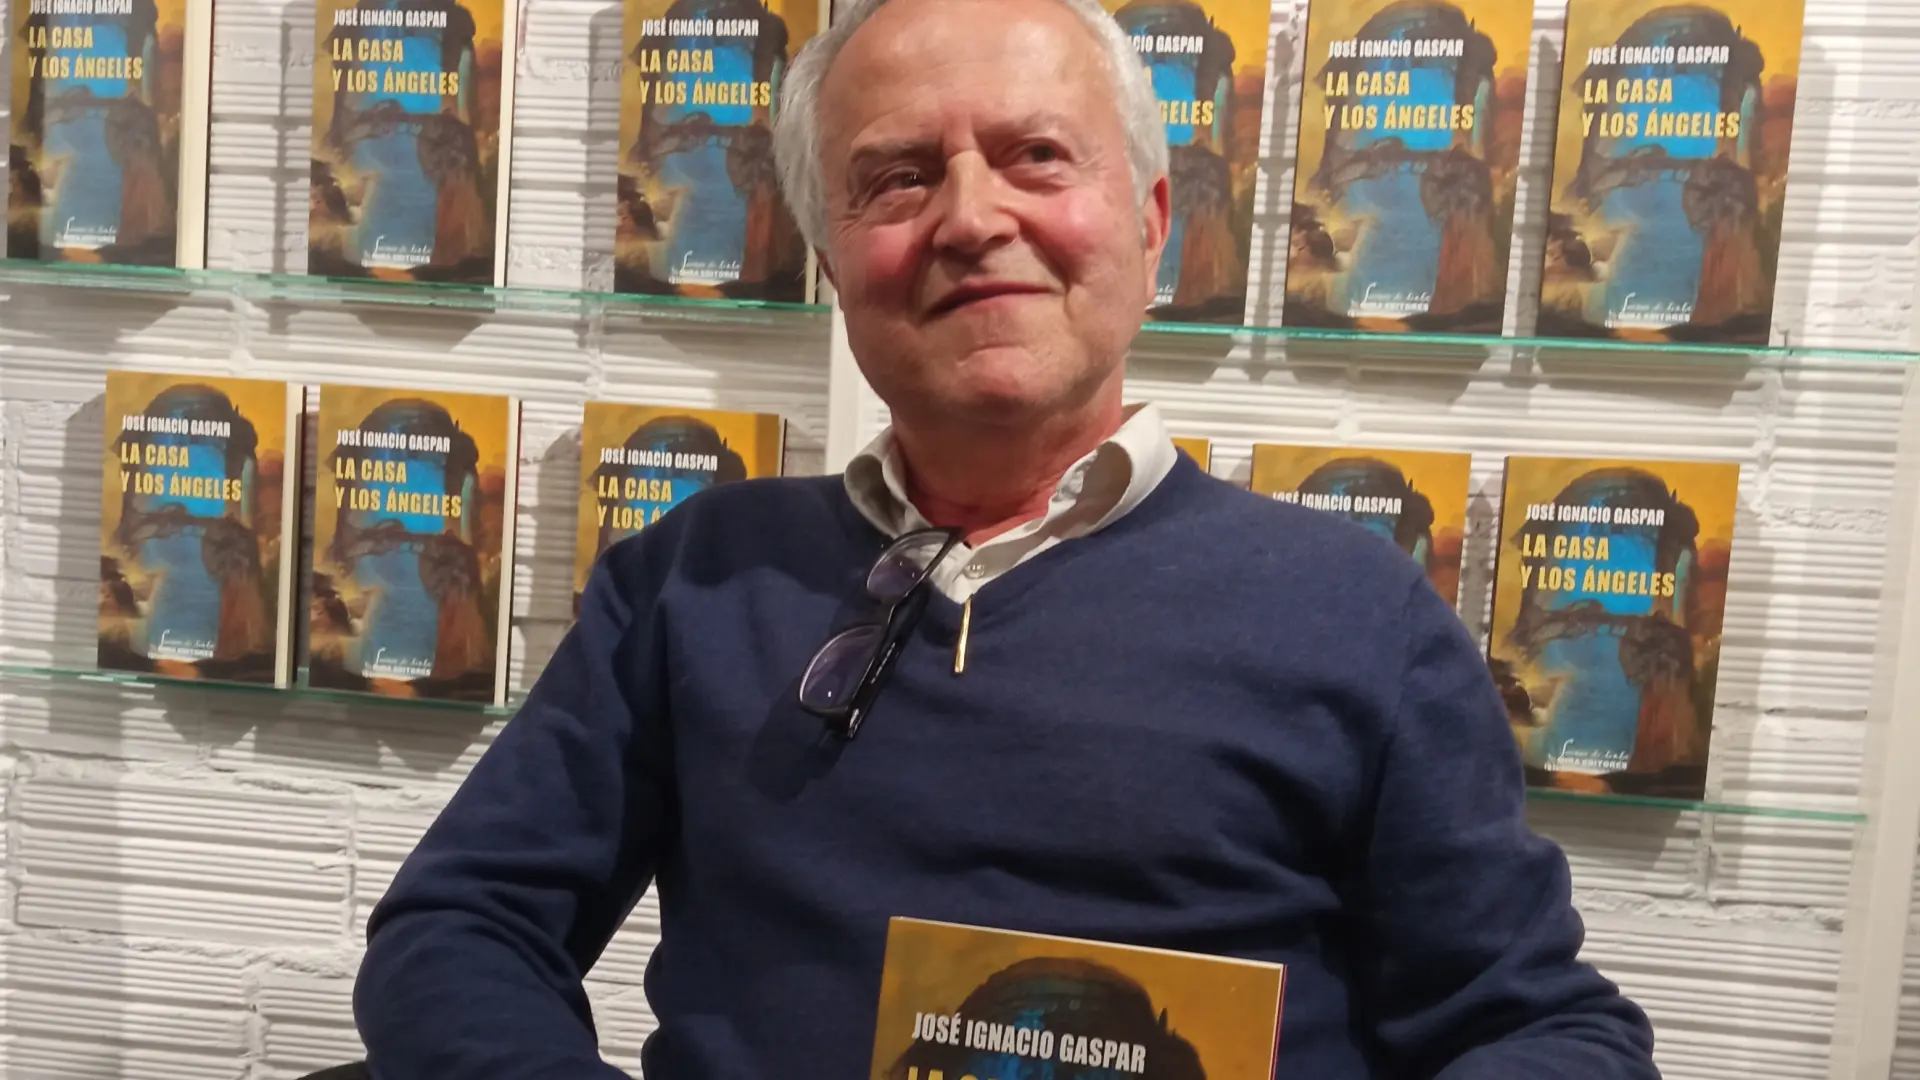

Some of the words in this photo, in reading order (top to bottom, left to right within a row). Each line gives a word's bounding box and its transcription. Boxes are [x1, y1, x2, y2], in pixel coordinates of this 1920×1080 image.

[334, 9, 357, 26] JOSÉ
[360, 10, 403, 27] IGNACIO
[405, 10, 447, 28] GASPAR
[641, 16, 666, 37] JOSÉ
[668, 18, 714, 36] IGNACIO
[716, 19, 759, 36] GASPAR
[28, 26, 47, 48] LA
[52, 26, 93, 48] CASA
[333, 38, 353, 62] LA
[358, 39, 404, 62] CASA
[1156, 35, 1203, 53] GASPAR
[1329, 37, 1357, 58] JOSÉ
[1360, 39, 1411, 57] IGNACIO
[1413, 39, 1464, 57] GASPAR
[28, 56, 37, 77] Y
[42, 56, 69, 78] LOS
[74, 53, 143, 79] ÁNGELES
[640, 49, 661, 73] LA
[666, 49, 714, 73] CASA
[1587, 44, 1617, 65] JOSÉ
[1620, 46, 1674, 65] IGNACIO
[1677, 46, 1729, 64] GASPAR
[332, 69, 342, 92] Y
[347, 69, 378, 93] LOS
[383, 68, 459, 96] ÁNGELES
[640, 80, 650, 104] Y
[655, 80, 687, 105] LOS
[692, 76, 771, 106] ÁNGELES
[1326, 71, 1349, 97] LA
[1355, 71, 1410, 97] CASA
[1584, 78, 1609, 104] LA
[1615, 78, 1673, 104] CASA
[1324, 104, 1335, 129] Y
[1341, 104, 1378, 130] LOS
[1383, 100, 1475, 130] ÁNGELES
[1582, 112, 1594, 138] Y
[1599, 112, 1638, 138] LOS
[1644, 108, 1740, 138] ÁNGELES
[122, 414, 145, 432] JOSÉ
[147, 416, 189, 435] IGNACIO
[190, 419, 231, 438] GASPAR
[337, 428, 361, 446] JOSÉ
[363, 430, 407, 450] IGNACIO
[408, 433, 451, 453] GASPAR
[121, 442, 140, 465] LA
[145, 444, 189, 468] CASA
[600, 447, 625, 465] JOSÉ
[627, 449, 672, 468] IGNACIO
[674, 452, 718, 472] GASPAR
[336, 456, 356, 480] LA
[361, 458, 407, 484] CASA
[120, 470, 130, 493] Y
[134, 472, 165, 495] LOS
[169, 472, 242, 501] ÁNGELES
[599, 475, 619, 499] LA
[624, 477, 672, 503] CASA
[335, 485, 345, 508] Y
[350, 488, 381, 511] LOS
[386, 487, 462, 517] ÁNGELES
[1354, 495, 1402, 515] GASPAR
[597, 504, 607, 528] Y
[612, 506, 645, 531] LOS
[1525, 502, 1555, 521] JOSÉ
[1557, 505, 1611, 524] IGNACIO
[1613, 507, 1665, 527] GASPAR
[1523, 533, 1547, 558] LA
[1553, 535, 1609, 561] CASA
[1520, 565, 1532, 589] Y
[1538, 566, 1577, 592] LOS
[1582, 565, 1675, 597] ÁNGELES
[912, 1011, 961, 1045] JOSÉ
[964, 1019, 1054, 1060] IGNACIO
[1059, 1033, 1147, 1074] GASPAR
